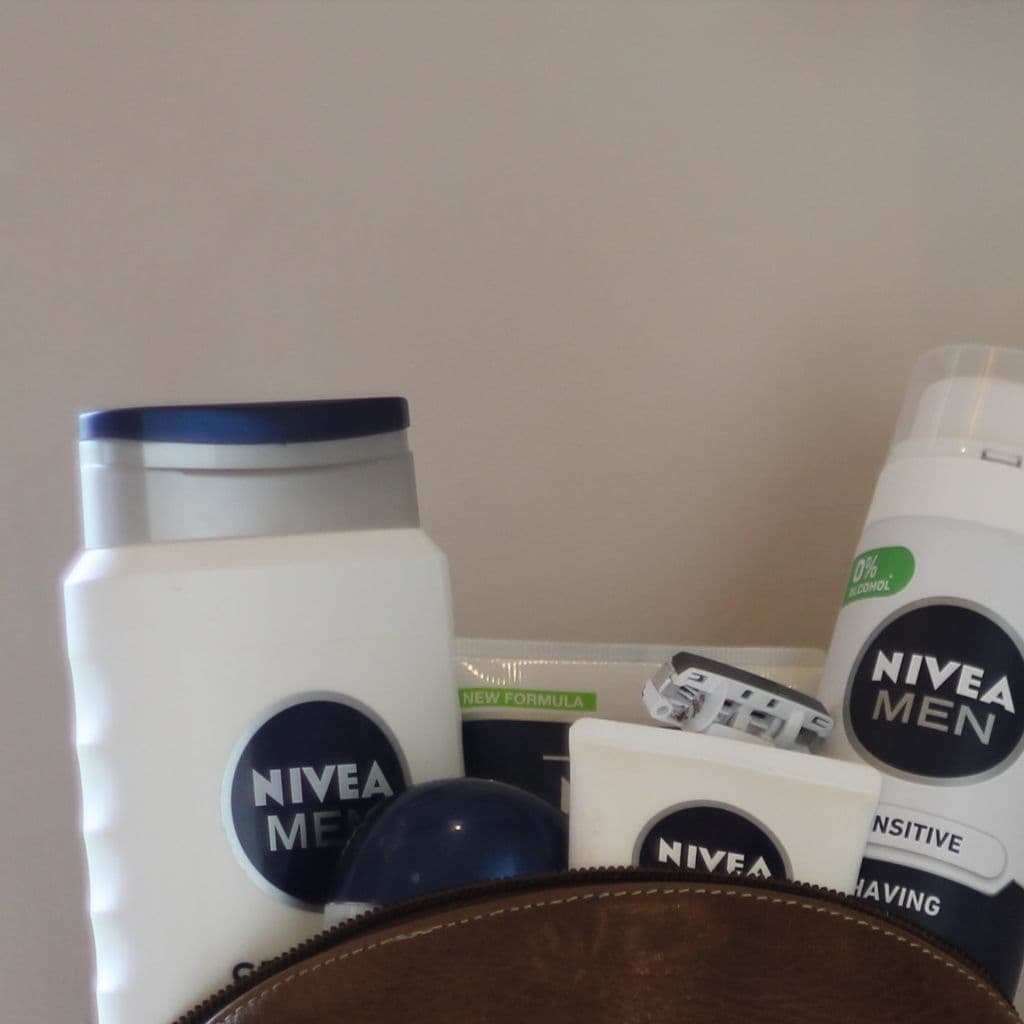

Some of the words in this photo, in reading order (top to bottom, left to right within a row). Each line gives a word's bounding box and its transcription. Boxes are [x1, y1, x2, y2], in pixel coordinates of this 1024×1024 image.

[853, 554, 879, 583] 0%
[463, 690, 500, 705] NEW
[505, 692, 584, 708] FORMULA
[872, 650, 1016, 714] NIVEA
[872, 690, 996, 745] MEN
[252, 760, 394, 807] NIVEA
[658, 836, 772, 879] NIVEA
